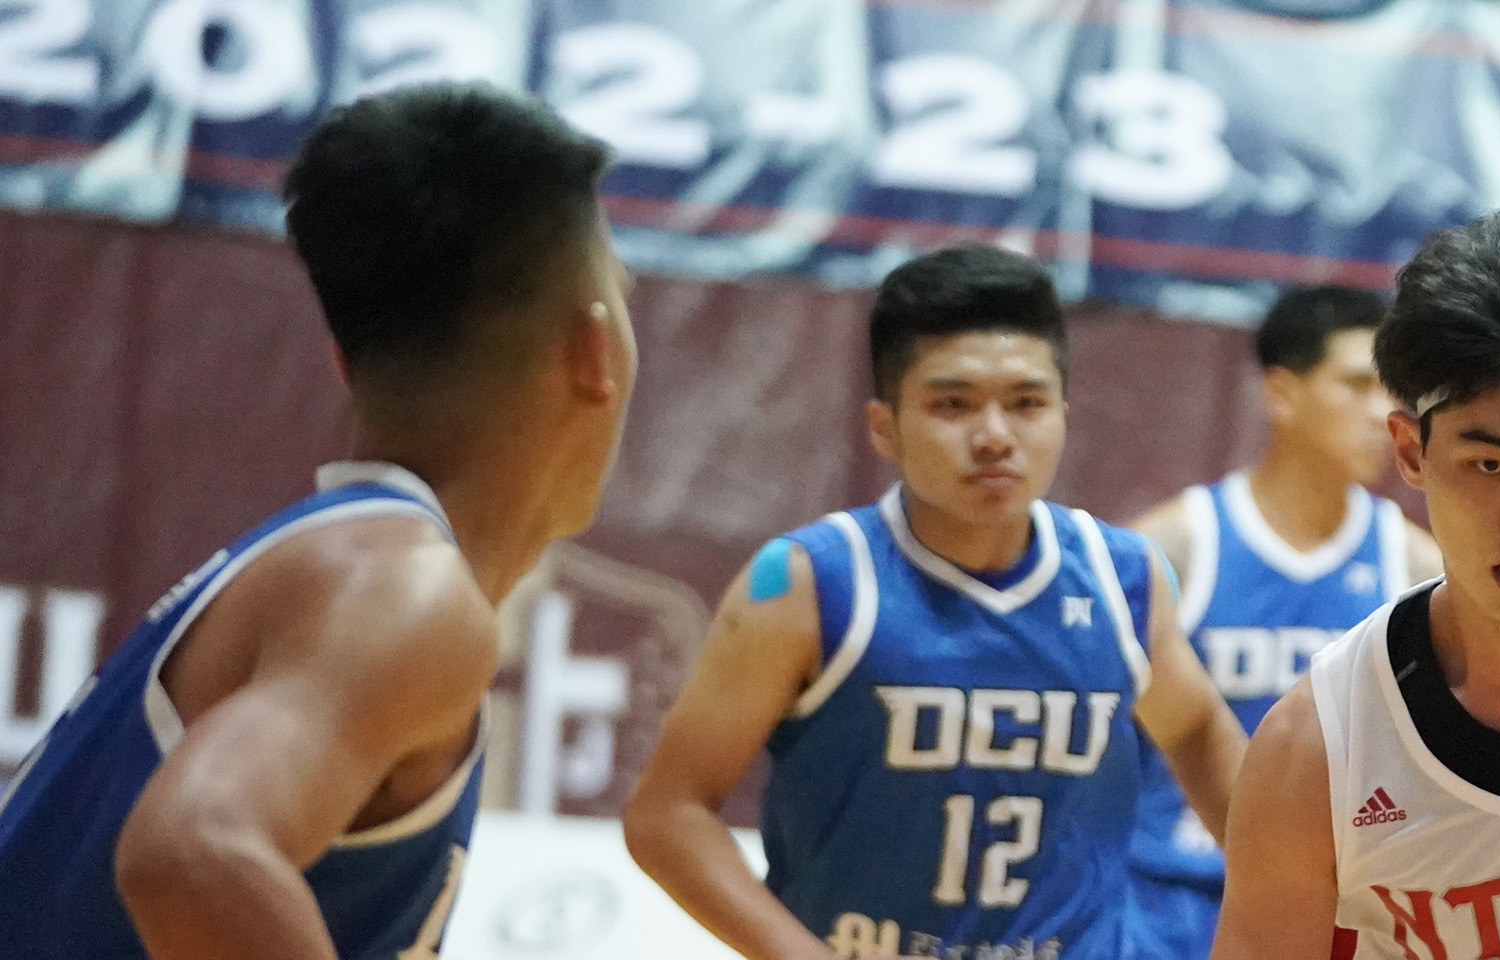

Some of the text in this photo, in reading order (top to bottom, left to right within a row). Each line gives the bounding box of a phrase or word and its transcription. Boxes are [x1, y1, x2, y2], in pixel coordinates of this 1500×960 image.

[1205, 627, 1348, 697] DC
[874, 685, 1121, 776] DCU
[930, 794, 1044, 908] 12
[1352, 809, 1407, 827] adidas
